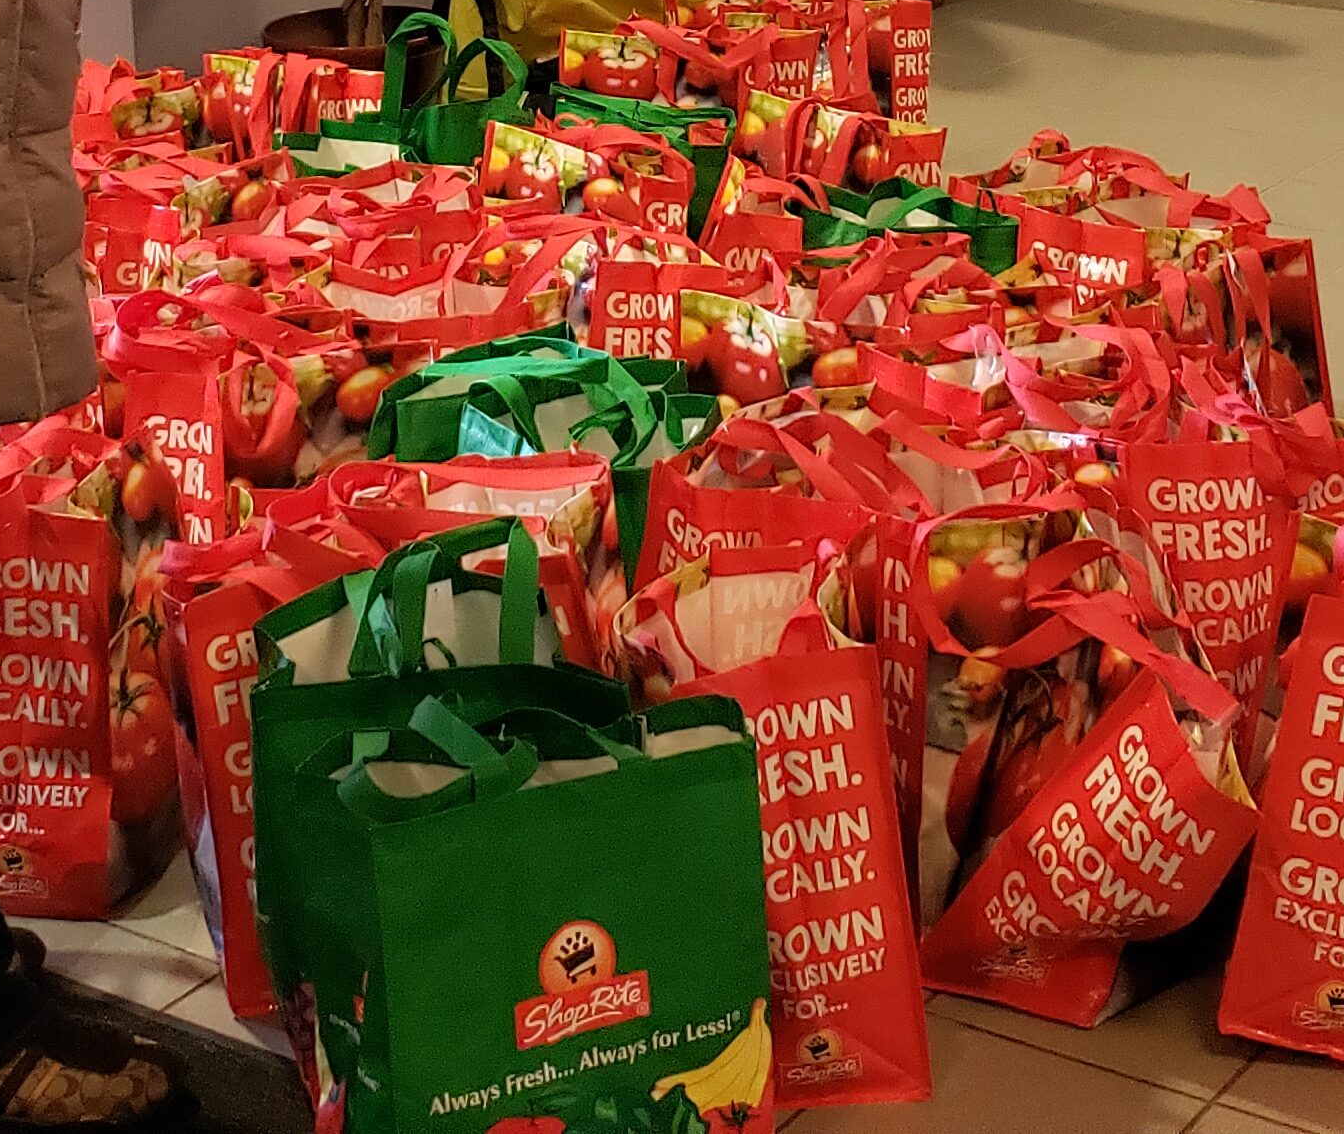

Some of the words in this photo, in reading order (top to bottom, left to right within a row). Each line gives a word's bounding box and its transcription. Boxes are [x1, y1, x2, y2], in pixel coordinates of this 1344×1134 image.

[894, 29, 931, 49] GRO
[896, 86, 929, 107] GRO
[605, 326, 673, 359] FRES
[1152, 514, 1273, 562] FRESH.
[1183, 566, 1273, 613] ROWN
[1196, 603, 1272, 647] CALLY.
[745, 694, 854, 751] OWN
[757, 743, 863, 806] ESH.
[1119, 724, 1216, 856] GROWN
[763, 806, 871, 865] ROWN
[1084, 755, 1184, 891] FRESH.
[766, 850, 876, 904] CALLY.
[1051, 802, 1171, 917] GROWN
[767, 906, 885, 964] ROWN
[770, 947, 886, 993] CLUSIVELY
[523, 978, 643, 1044] ShopRite
[782, 993, 849, 1020] FOR...
[429, 1082, 501, 1117] Always
[504, 1061, 574, 1097] Fresh...
[578, 1036, 648, 1074] Always
[652, 1028, 681, 1052] for
